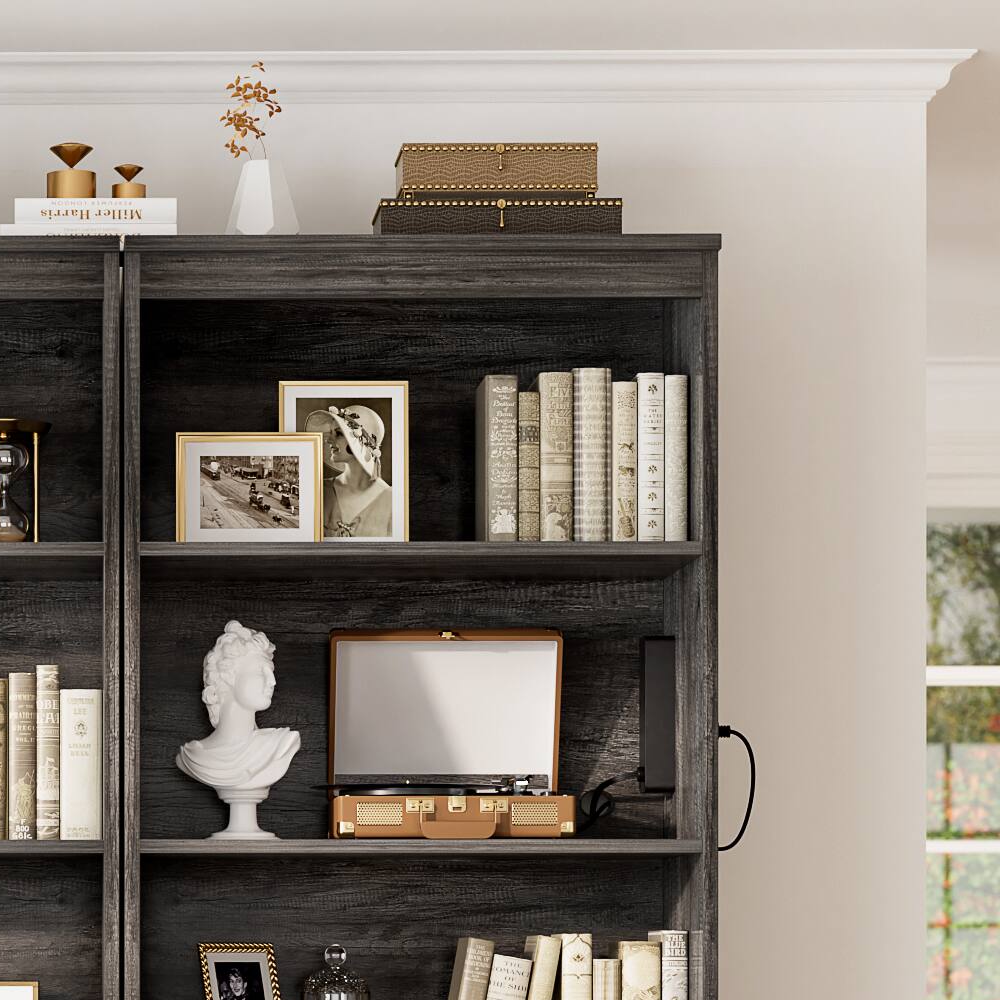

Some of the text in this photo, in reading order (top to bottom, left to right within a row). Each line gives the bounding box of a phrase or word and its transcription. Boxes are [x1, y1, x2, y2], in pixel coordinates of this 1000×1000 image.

[39, 208, 143, 220] Miller Harris
[664, 948, 686, 956] BIRD
